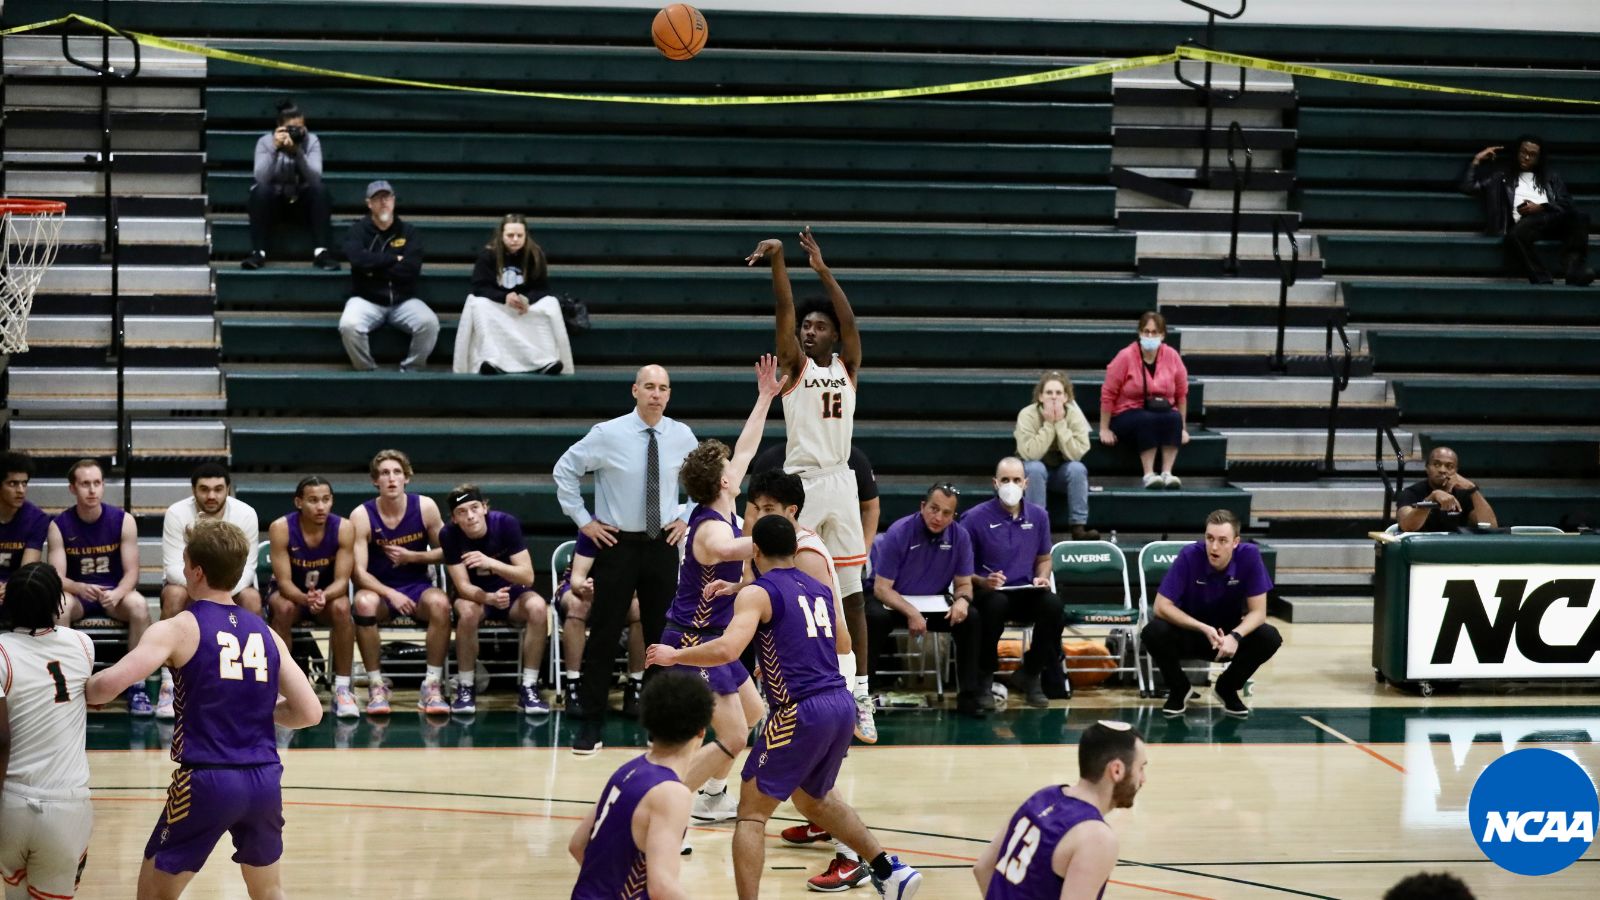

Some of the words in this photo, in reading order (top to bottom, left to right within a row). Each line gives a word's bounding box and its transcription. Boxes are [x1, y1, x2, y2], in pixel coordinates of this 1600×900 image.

[822, 392, 842, 418] 12
[80, 556, 110, 575] 22
[797, 594, 833, 639] 14
[1084, 615, 1132, 623] LEOPARDS
[1430, 578, 1600, 664] NC
[216, 631, 268, 683] 24
[46, 660, 71, 704] 1
[995, 816, 1041, 885] 13
